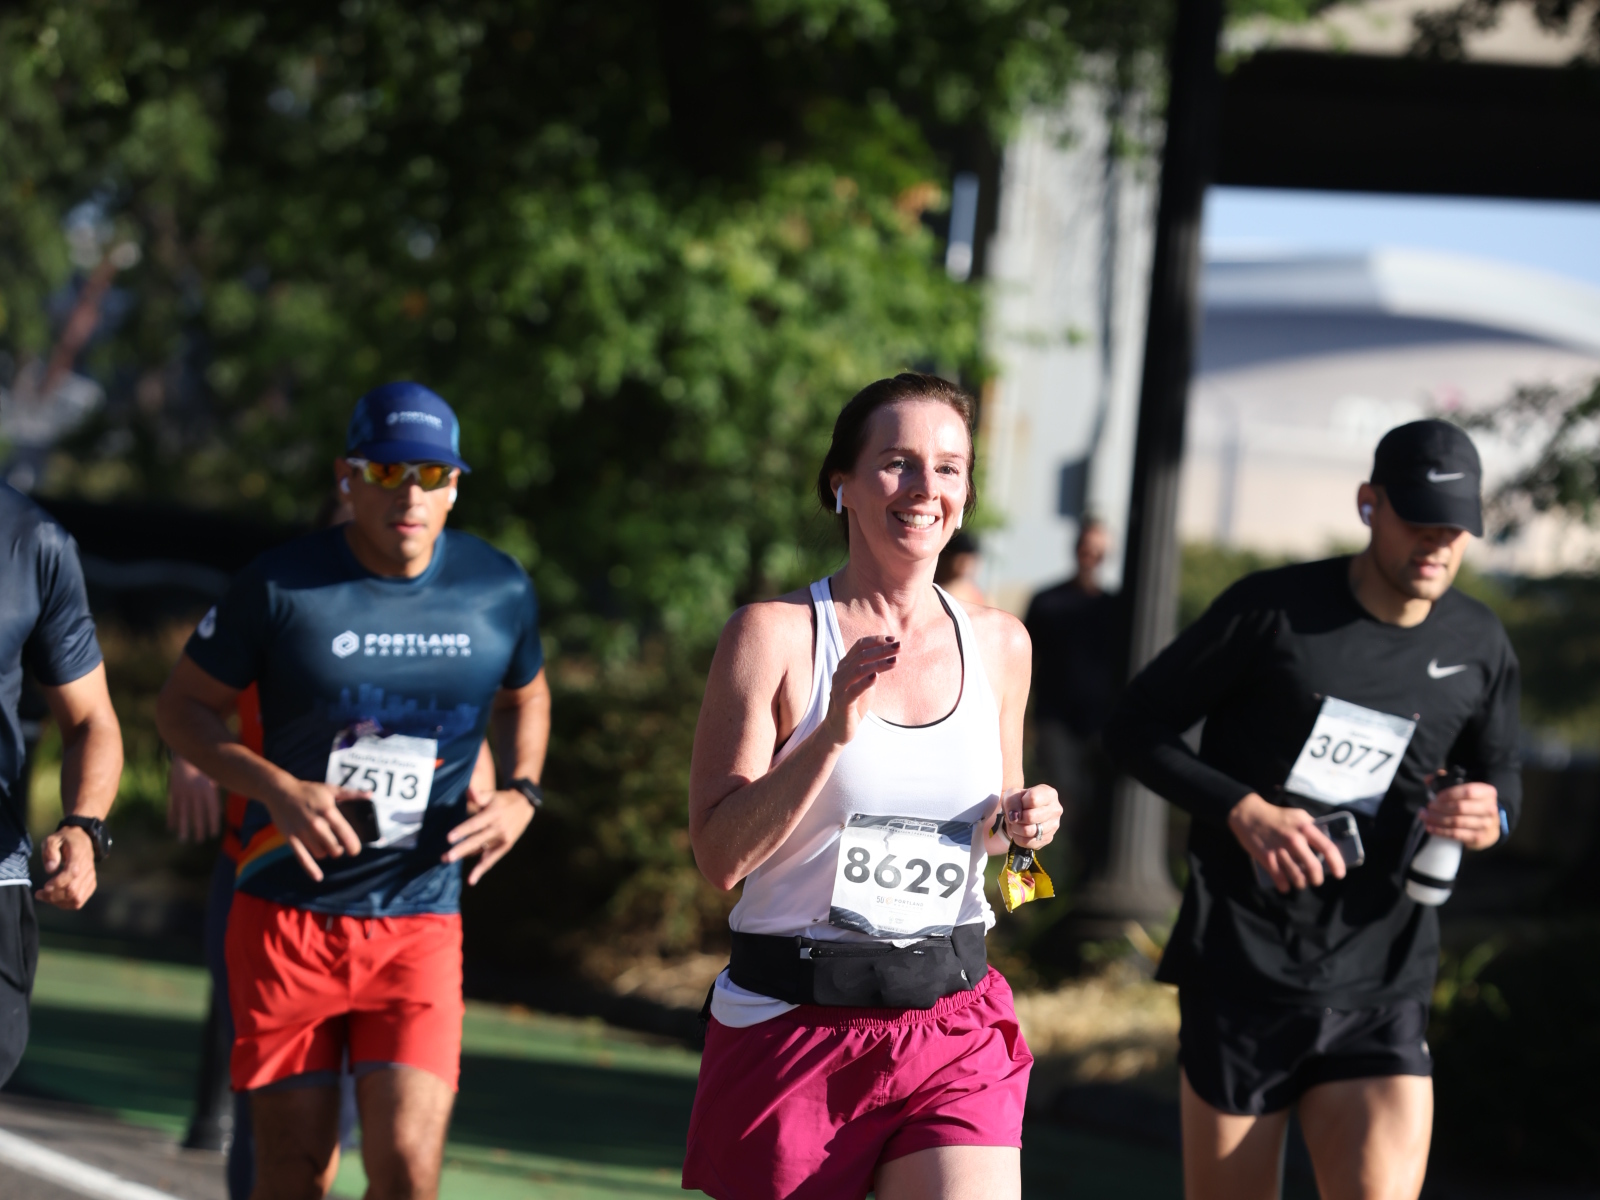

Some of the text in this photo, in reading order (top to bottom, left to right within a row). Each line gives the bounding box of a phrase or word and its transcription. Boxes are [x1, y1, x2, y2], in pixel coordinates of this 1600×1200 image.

[364, 633, 471, 647] PORTLAND
[364, 646, 472, 657] MARATHON
[1310, 734, 1395, 774] 3077
[340, 763, 419, 800] 7513
[844, 846, 965, 899] 8629
[894, 898, 924, 906] PORTLAND
